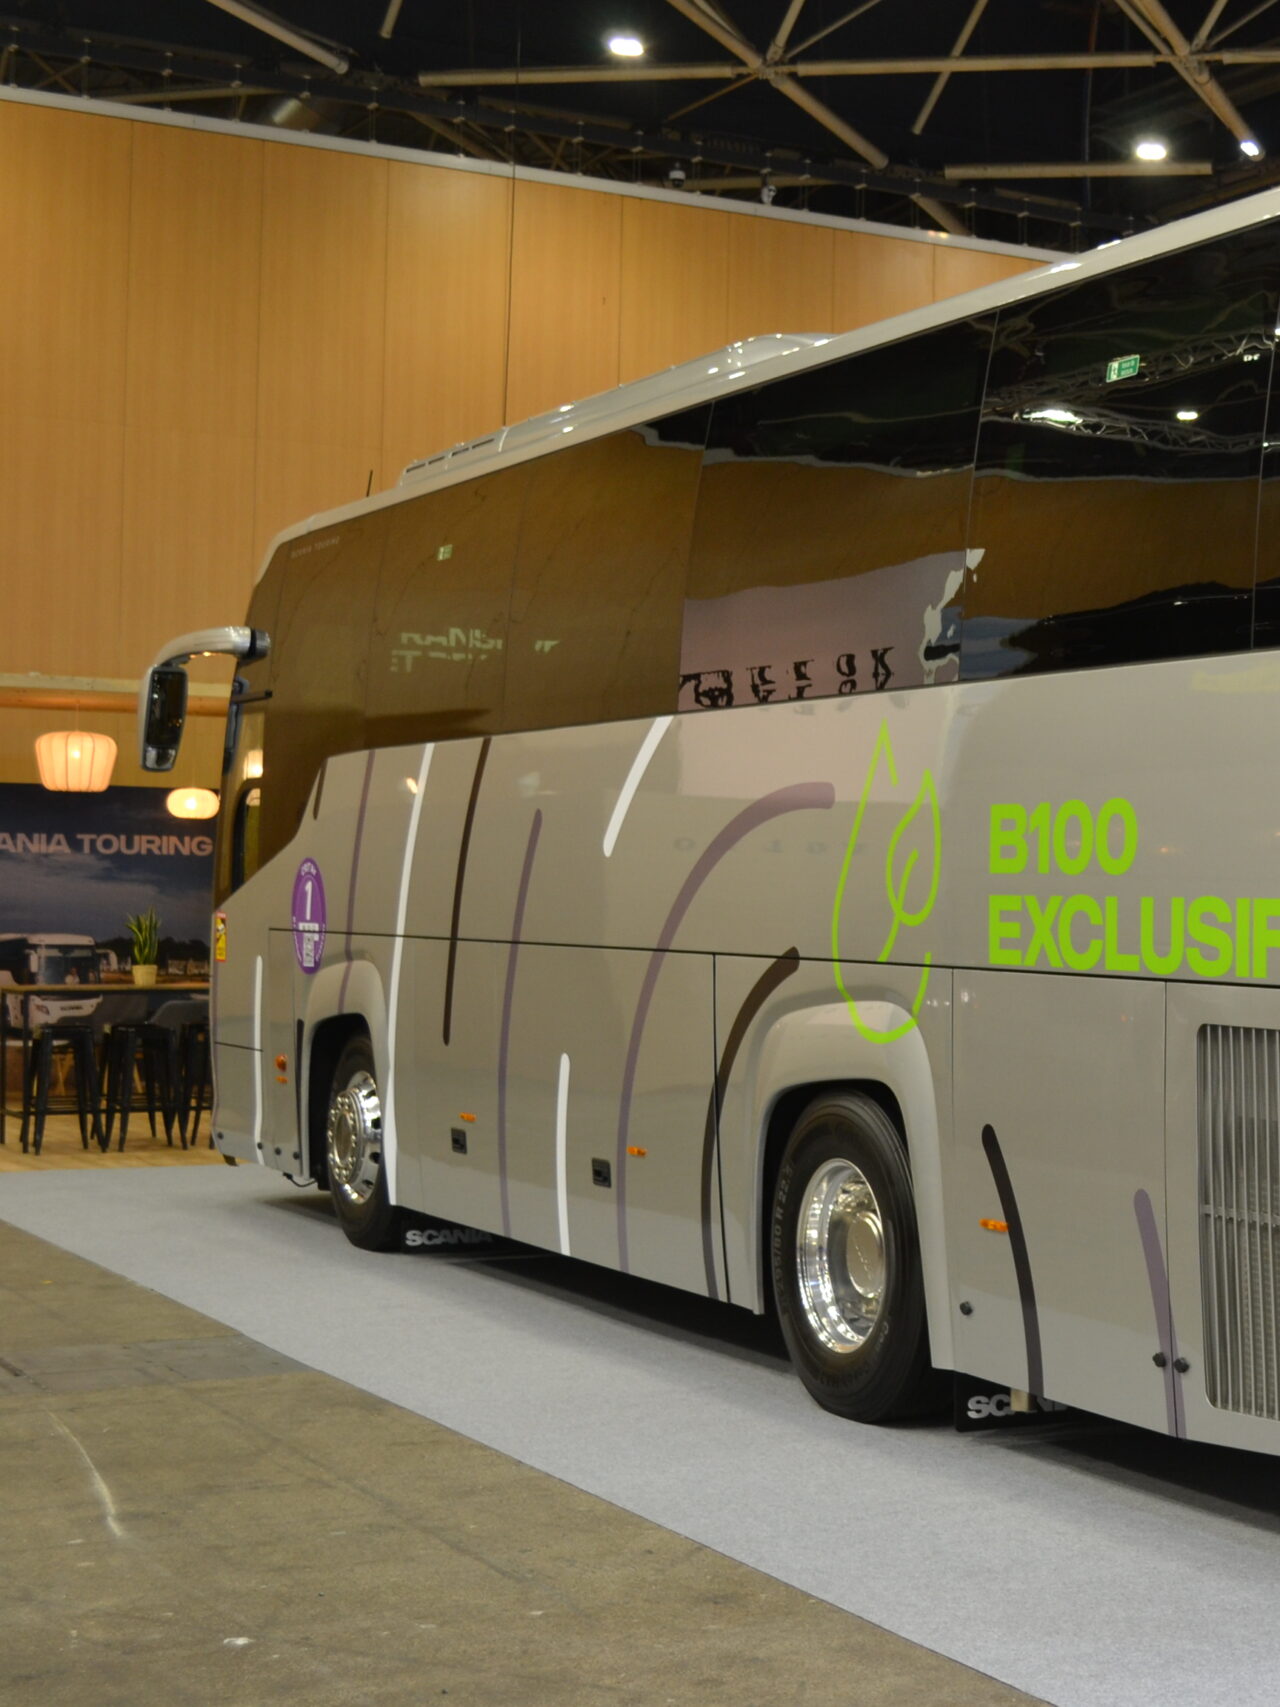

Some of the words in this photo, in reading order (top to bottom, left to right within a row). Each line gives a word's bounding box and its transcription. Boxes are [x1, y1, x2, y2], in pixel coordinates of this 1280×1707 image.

[76, 833, 214, 856] TOURING
[989, 797, 1138, 875] B100
[305, 880, 313, 921] 1
